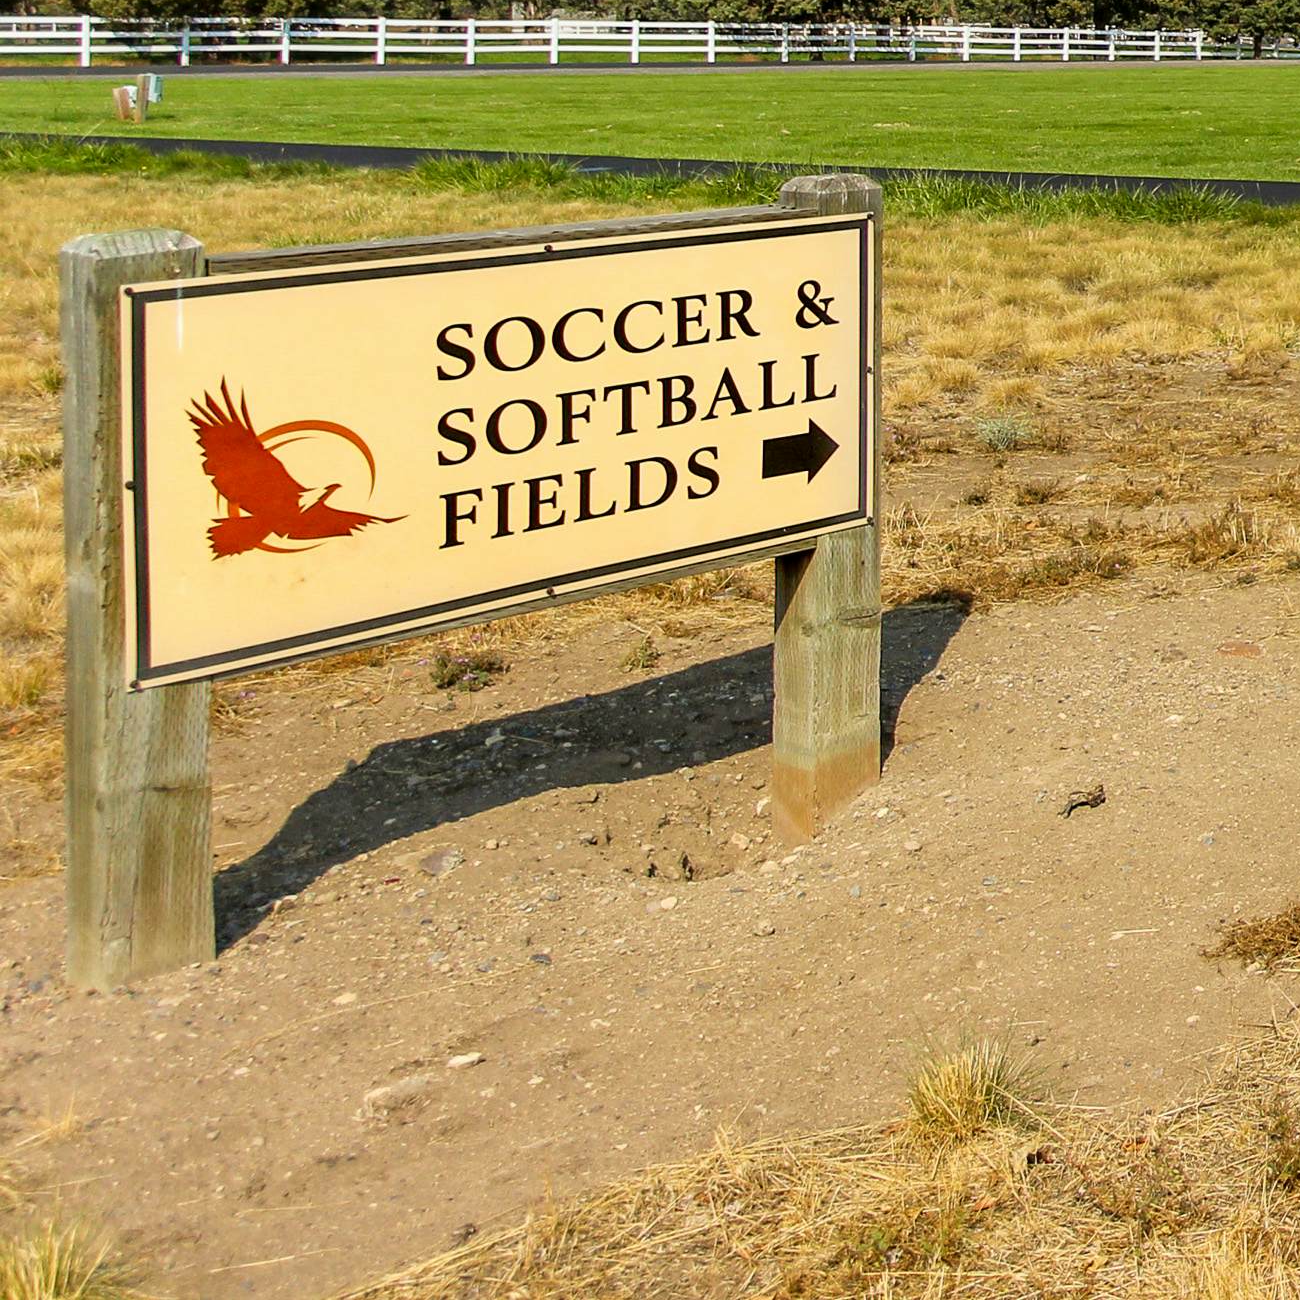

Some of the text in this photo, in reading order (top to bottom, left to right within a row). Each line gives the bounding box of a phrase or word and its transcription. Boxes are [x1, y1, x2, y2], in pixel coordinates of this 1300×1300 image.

[436, 279, 840, 382] SOCCER &
[437, 353, 837, 467] SOFTBALL
[438, 446, 721, 550] FIELDS
